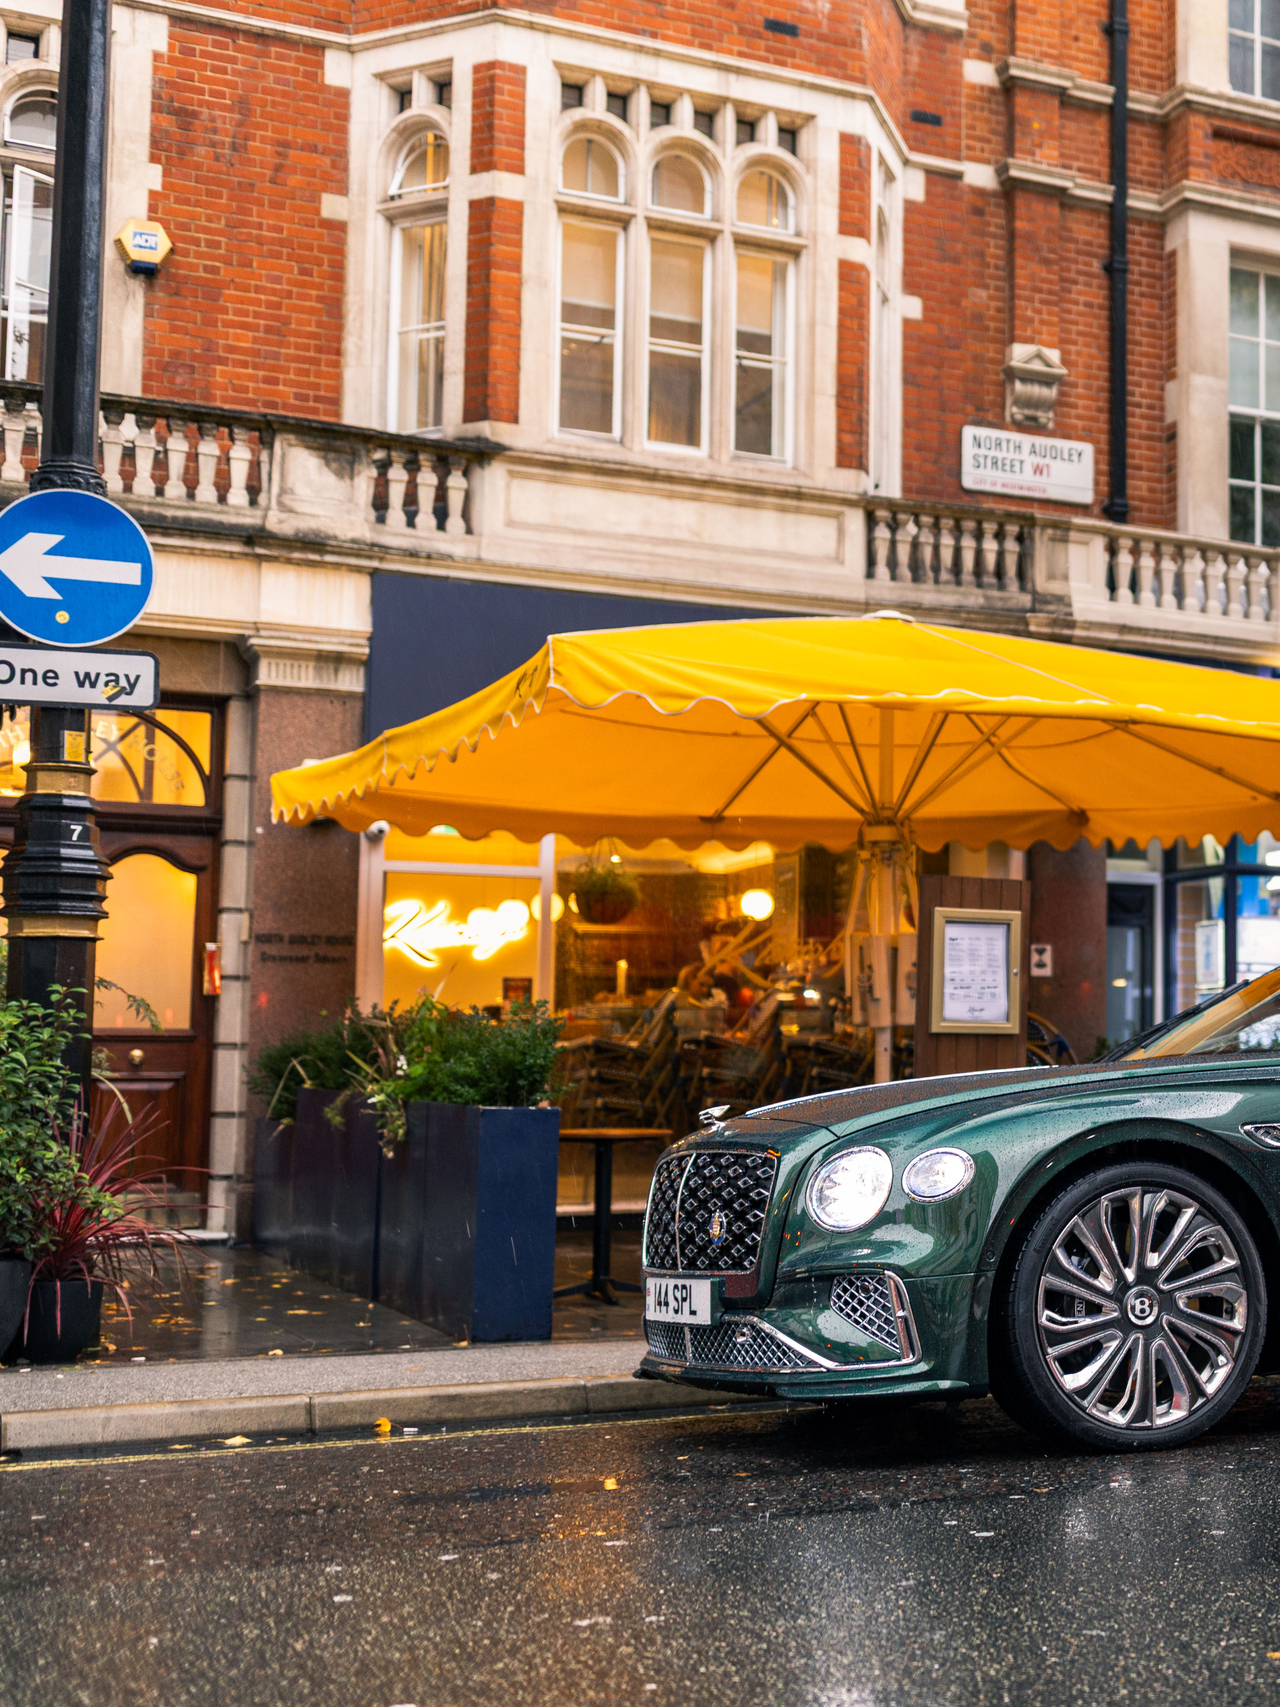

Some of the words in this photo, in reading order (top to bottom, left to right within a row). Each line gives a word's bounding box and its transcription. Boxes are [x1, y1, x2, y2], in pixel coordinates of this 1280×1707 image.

[972, 434, 1022, 455] NORTH
[1029, 441, 1083, 463] AUDLEY
[972, 453, 1025, 474] STREET
[1031, 461, 1050, 478] W1
[0, 660, 59, 687] One
[74, 670, 141, 695] way
[69, 825, 83, 841] 7
[673, 1283, 697, 1316] SPL
